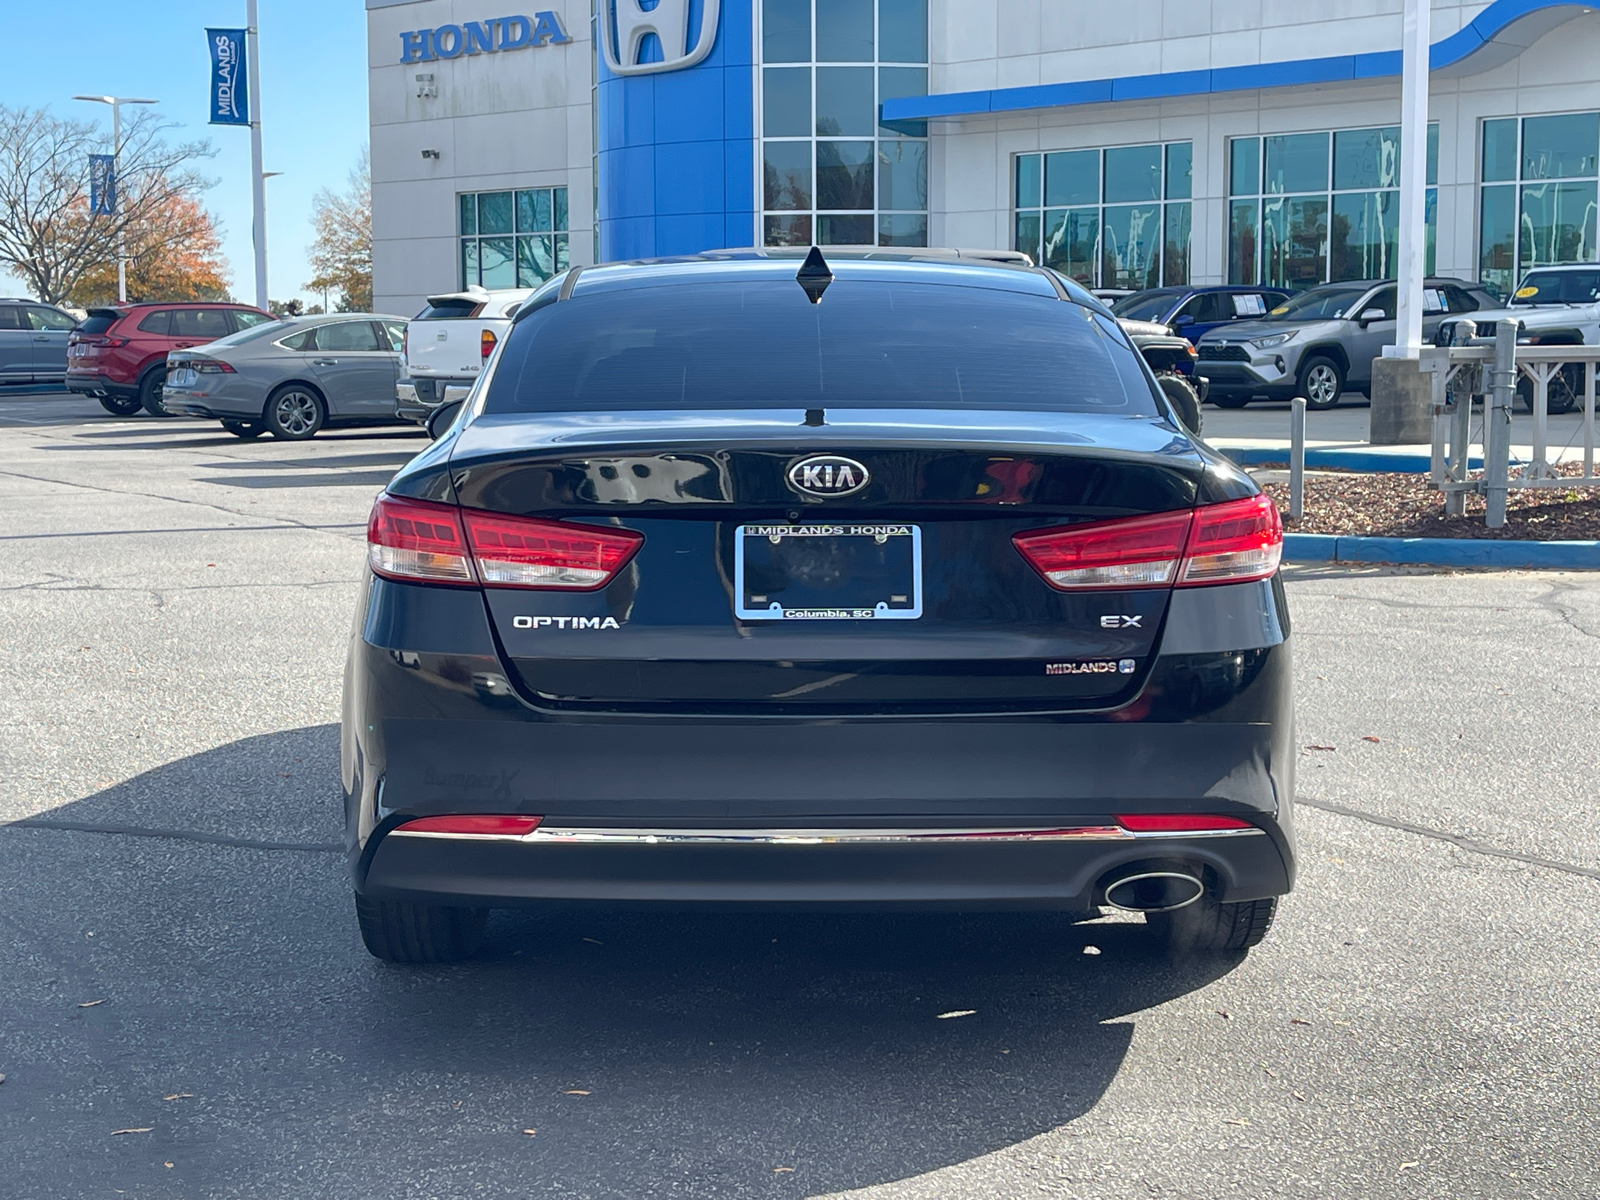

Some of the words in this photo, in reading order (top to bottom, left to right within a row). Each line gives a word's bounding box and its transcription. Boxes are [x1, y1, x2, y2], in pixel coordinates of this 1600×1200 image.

[400, 11, 571, 64] HONDA
[216, 35, 231, 115] MIDLANDS
[802, 465, 856, 488] KIA
[758, 526, 844, 535] MIDLANDS
[850, 526, 910, 535] HONDA
[853, 610, 873, 618] SC
[512, 615, 621, 629] OPTIMA
[1100, 615, 1143, 628] EX
[1045, 661, 1117, 675] MIDLANDS
